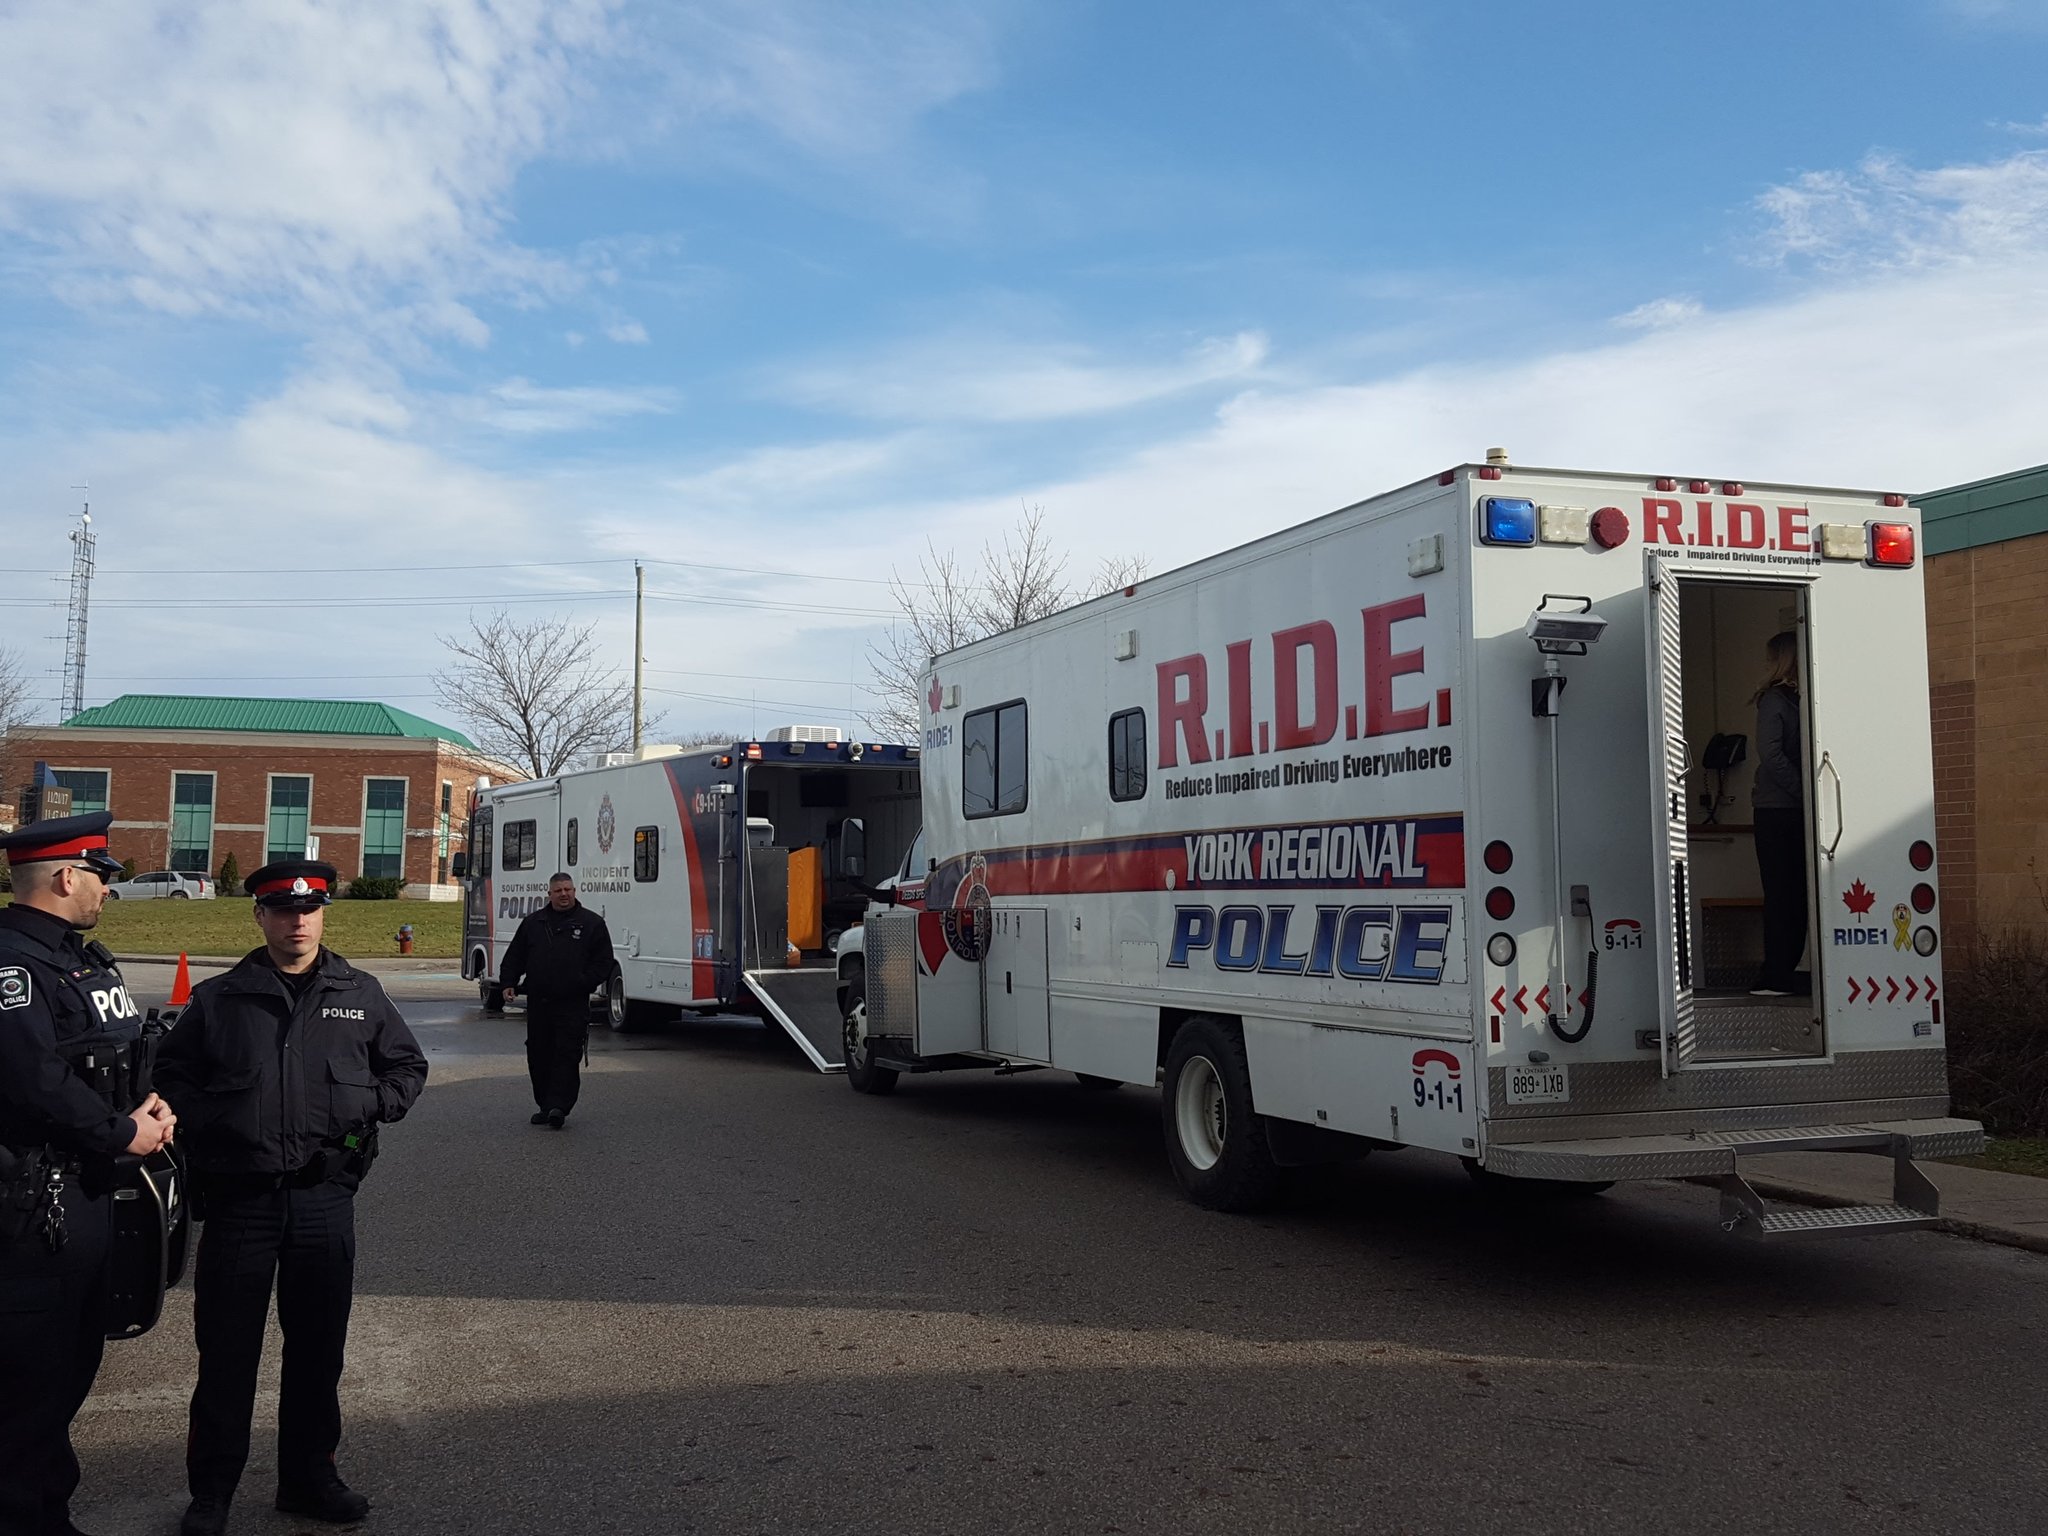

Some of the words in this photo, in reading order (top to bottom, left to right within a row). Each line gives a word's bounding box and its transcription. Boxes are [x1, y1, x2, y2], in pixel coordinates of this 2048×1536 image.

[1642, 497, 1820, 553] R.I.D.E.
[1687, 550, 1730, 561] Impaired
[1732, 553, 1766, 564] Driving
[1767, 555, 1821, 566] Everywhere
[1155, 593, 1452, 770] R.I.D.E.
[926, 725, 953, 750] RIDE1
[1165, 778, 1212, 800] Reduce
[1215, 764, 1280, 795] Impaired
[1283, 758, 1340, 786] Driving
[1343, 745, 1452, 778] Everywhere
[1184, 831, 1255, 882] YORK
[1260, 822, 1425, 880] REGIONAL
[582, 866, 630, 878] INCIDENT
[501, 884, 525, 893] SOUTH
[526, 883, 550, 892] SIMCO
[580, 881, 631, 893] COMMAND
[498, 896, 549, 920] POLIC
[1166, 904, 1453, 985] POLICE
[1605, 934, 1642, 950] 9-1-1
[1834, 928, 1888, 945] RIDE1
[4, 995, 27, 1005] POLICE
[322, 1008, 365, 1020] POLICE
[1413, 1077, 1463, 1113] 9-1-1
